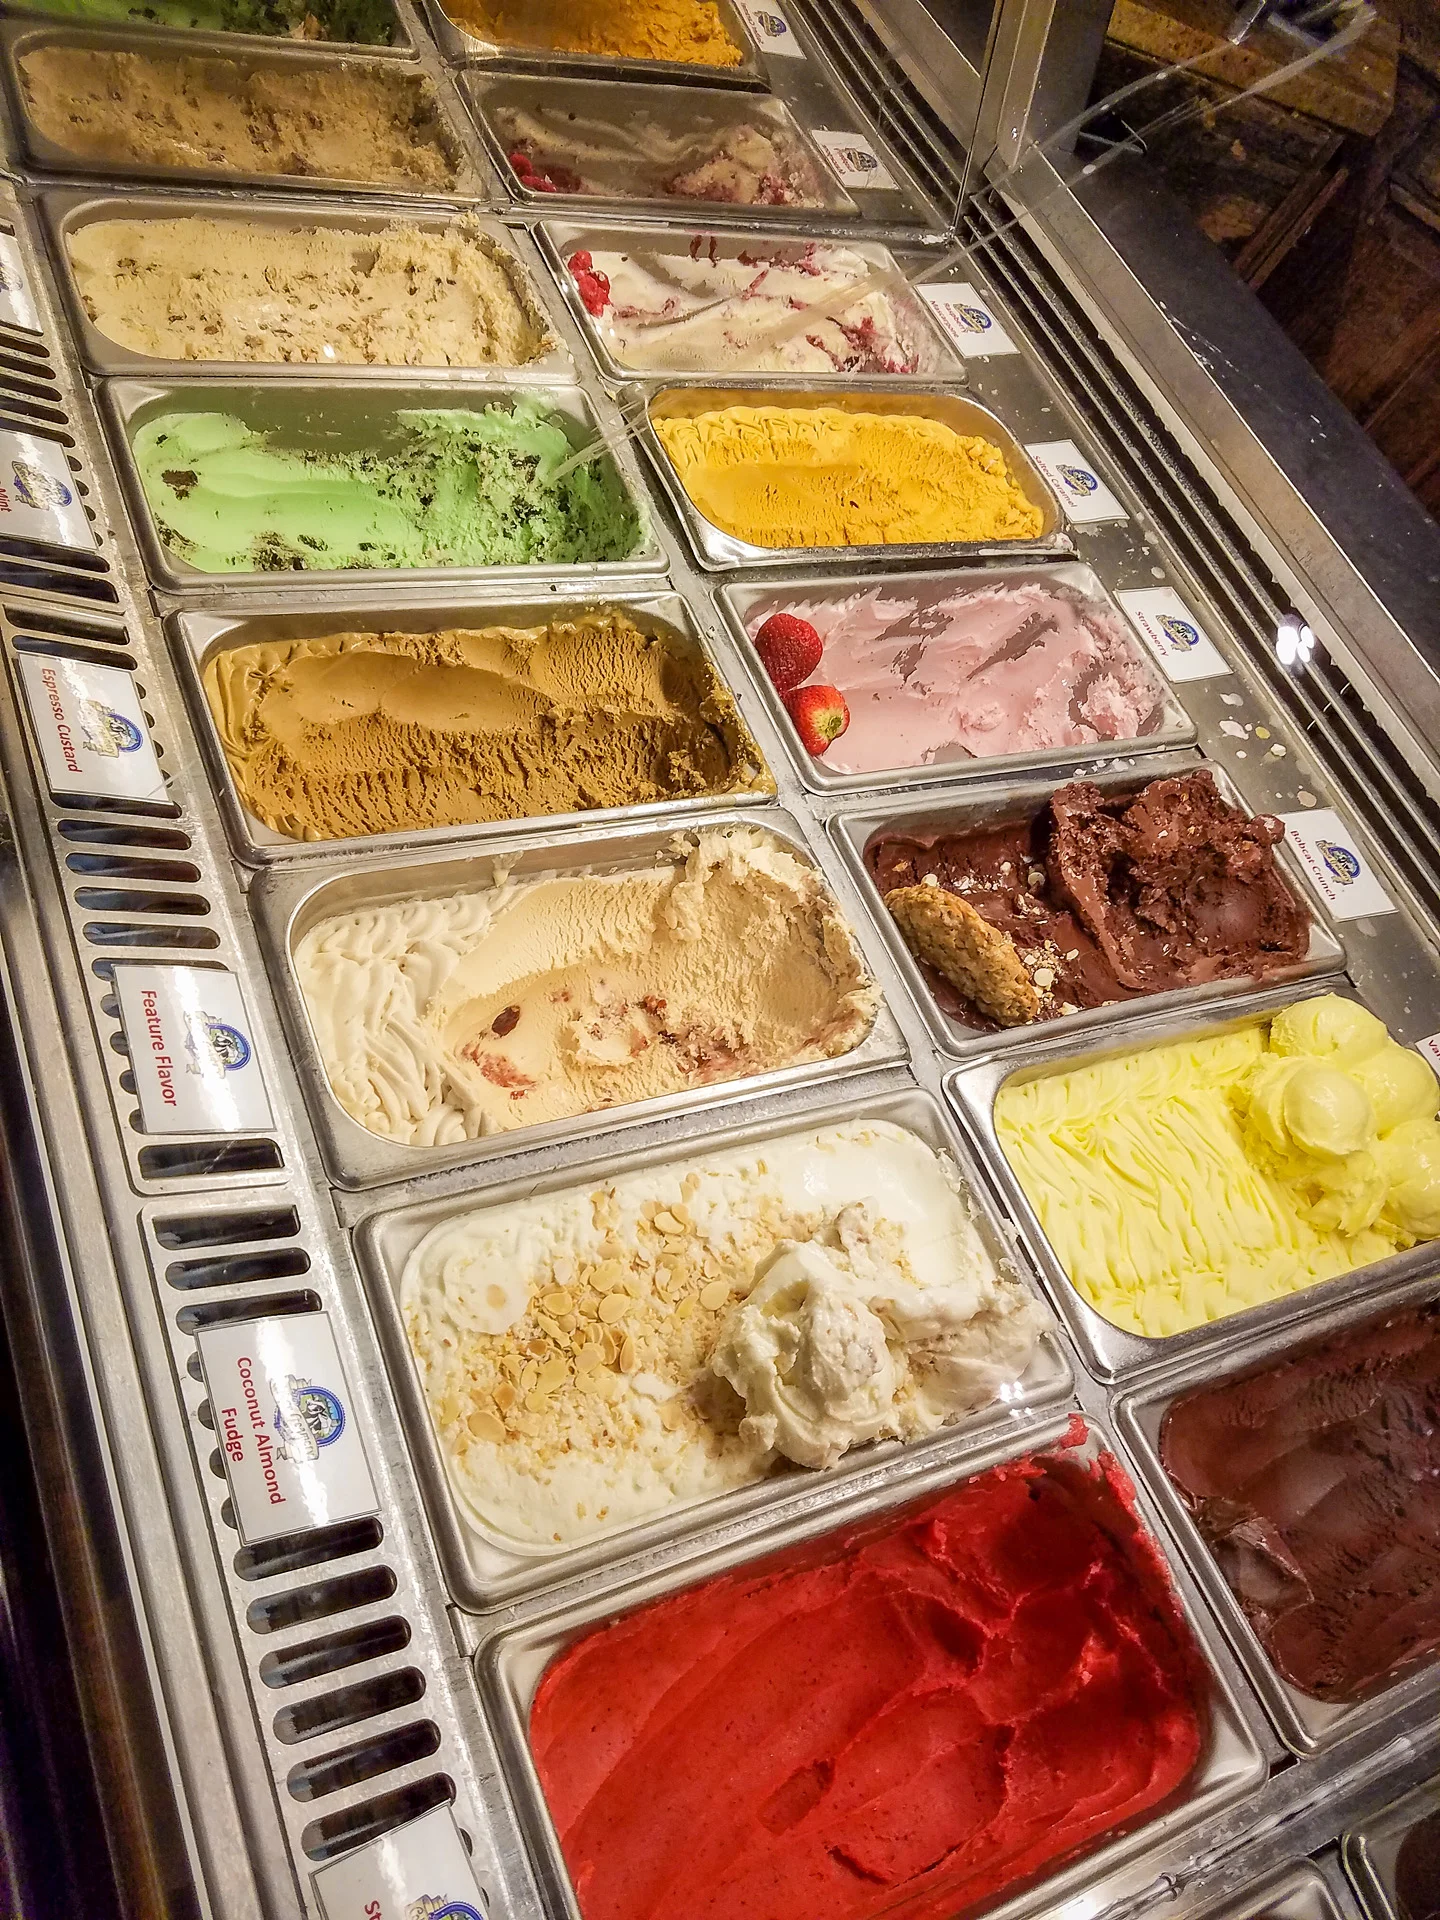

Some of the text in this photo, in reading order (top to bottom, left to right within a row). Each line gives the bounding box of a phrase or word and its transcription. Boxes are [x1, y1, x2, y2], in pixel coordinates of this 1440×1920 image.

[930, 300, 959, 338] Mascarpone
[1033, 455, 1054, 478] Salted
[1051, 478, 1078, 508] Caramel
[1135, 611, 1169, 657] Strawberry
[42, 668, 83, 773] Espresso Custard
[1290, 830, 1315, 864] Bobcat
[1312, 865, 1336, 900] Crunch
[141, 990, 177, 1107] Feature Flavor
[221, 1407, 244, 1462] Fudge
[237, 1356, 286, 1505] Coconut Almond
